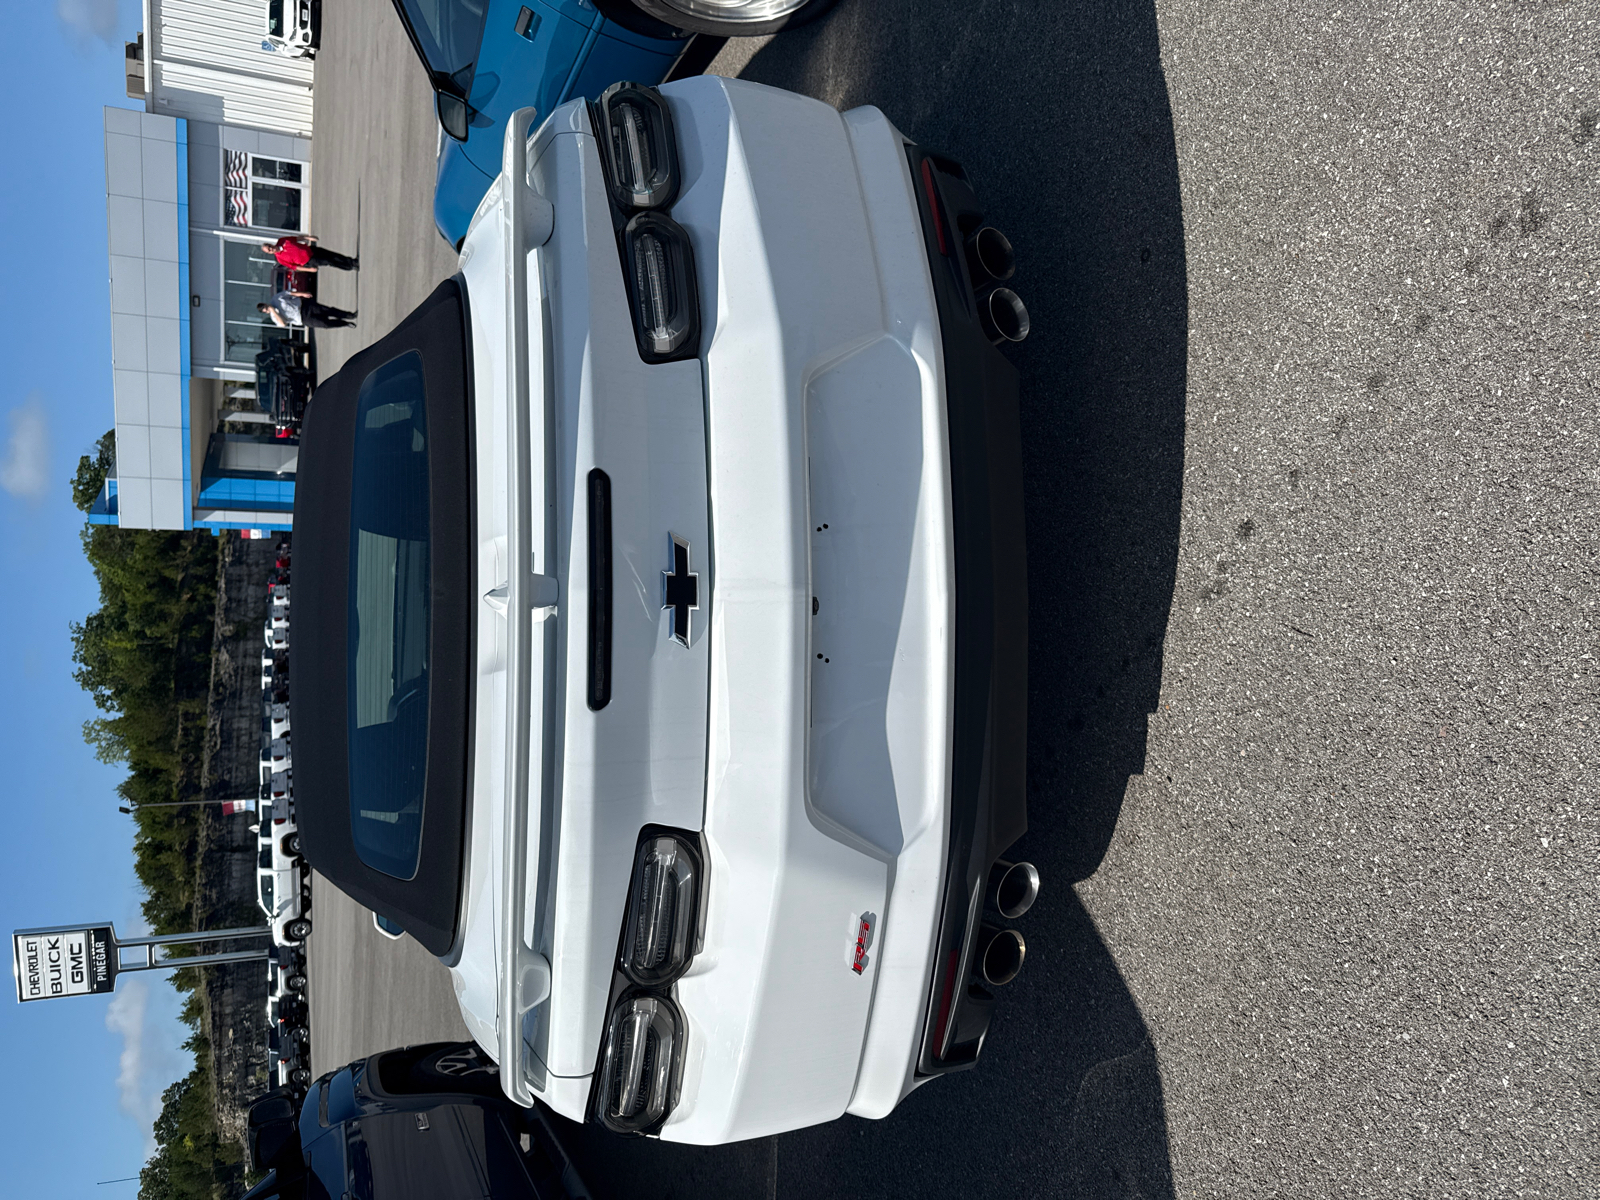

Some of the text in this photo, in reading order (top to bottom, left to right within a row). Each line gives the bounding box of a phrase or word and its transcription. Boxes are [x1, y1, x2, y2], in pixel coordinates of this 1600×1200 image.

[26, 940, 41, 996] CHEVROLET
[47, 936, 63, 994] BUICK
[69, 942, 84, 984] GMC
[95, 941, 107, 982] PINEGAR
[851, 917, 870, 976] RS
